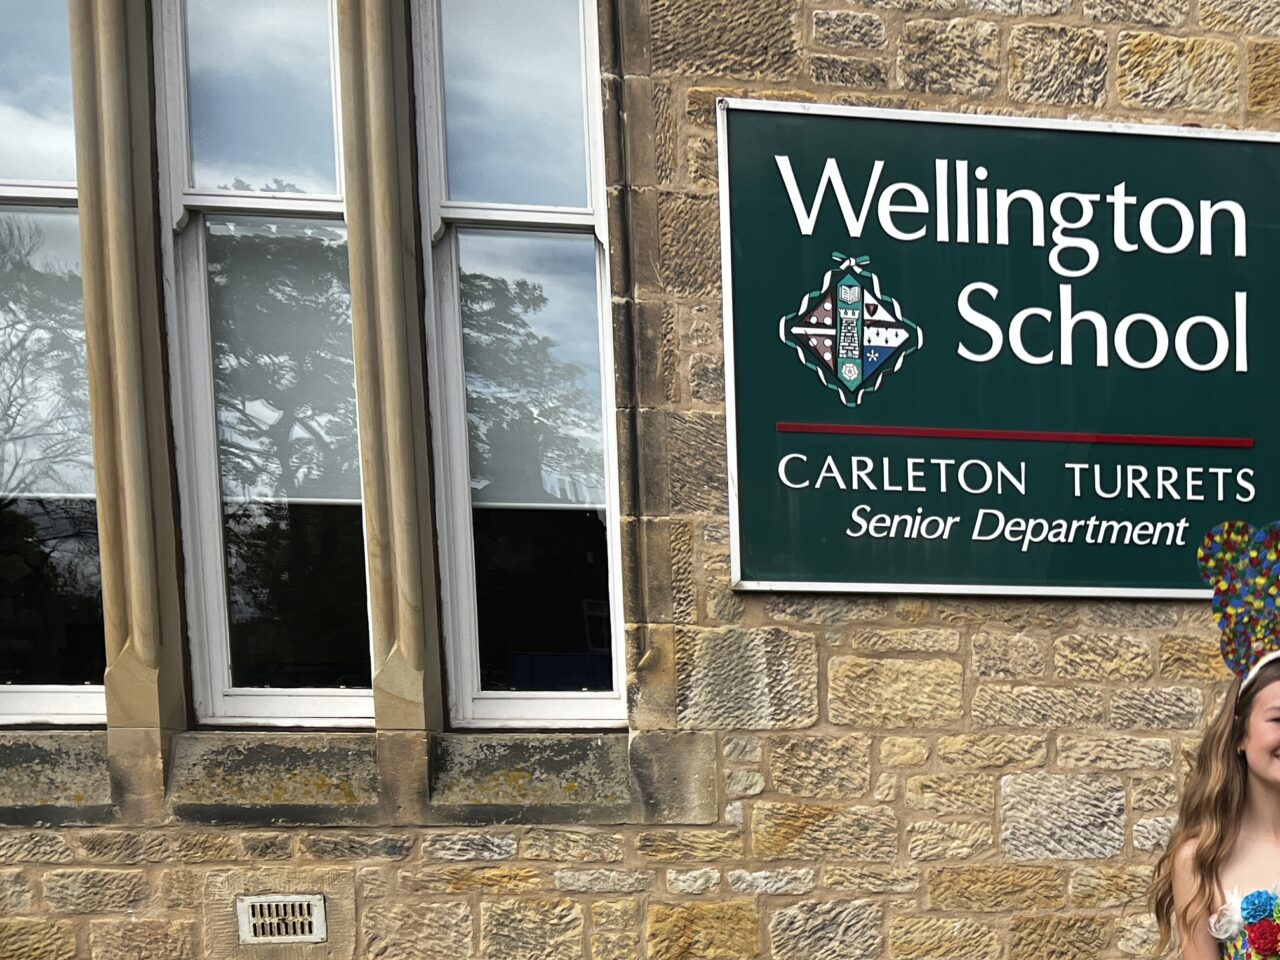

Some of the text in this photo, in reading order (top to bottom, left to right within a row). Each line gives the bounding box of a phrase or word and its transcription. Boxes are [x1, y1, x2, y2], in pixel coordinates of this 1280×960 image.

[774, 154, 1247, 278] Wellington
[957, 282, 1248, 373] School
[777, 453, 1256, 503] CARLETON TURRETS
[845, 504, 1190, 552] Senior Department
